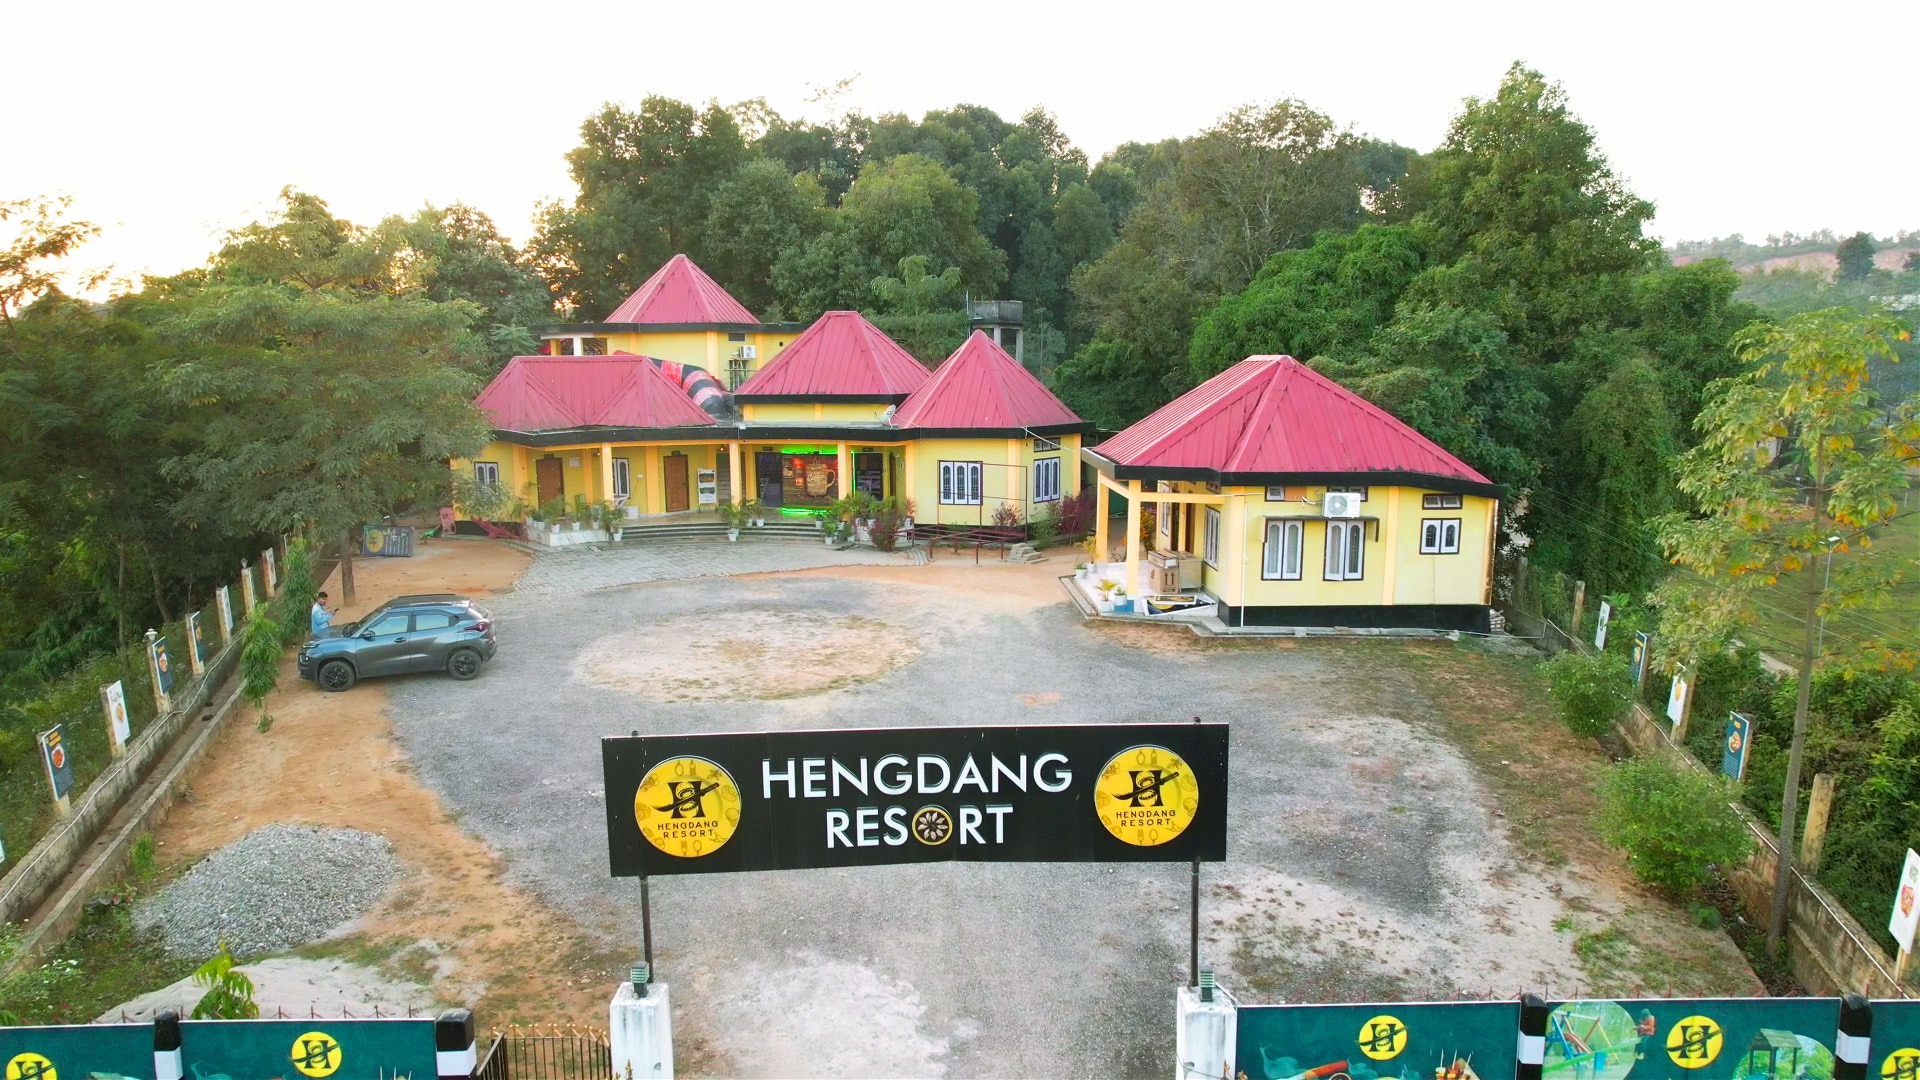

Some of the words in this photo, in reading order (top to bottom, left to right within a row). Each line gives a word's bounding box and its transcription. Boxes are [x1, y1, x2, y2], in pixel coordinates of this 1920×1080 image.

[761, 751, 1074, 799] HENGDANG
[1115, 809, 1176, 819] HENGDANG
[657, 820, 719, 831] HENGDANG
[825, 803, 1014, 849] RESORT
[1120, 818, 1171, 827] RESORT
[663, 829, 714, 839] RESORT
